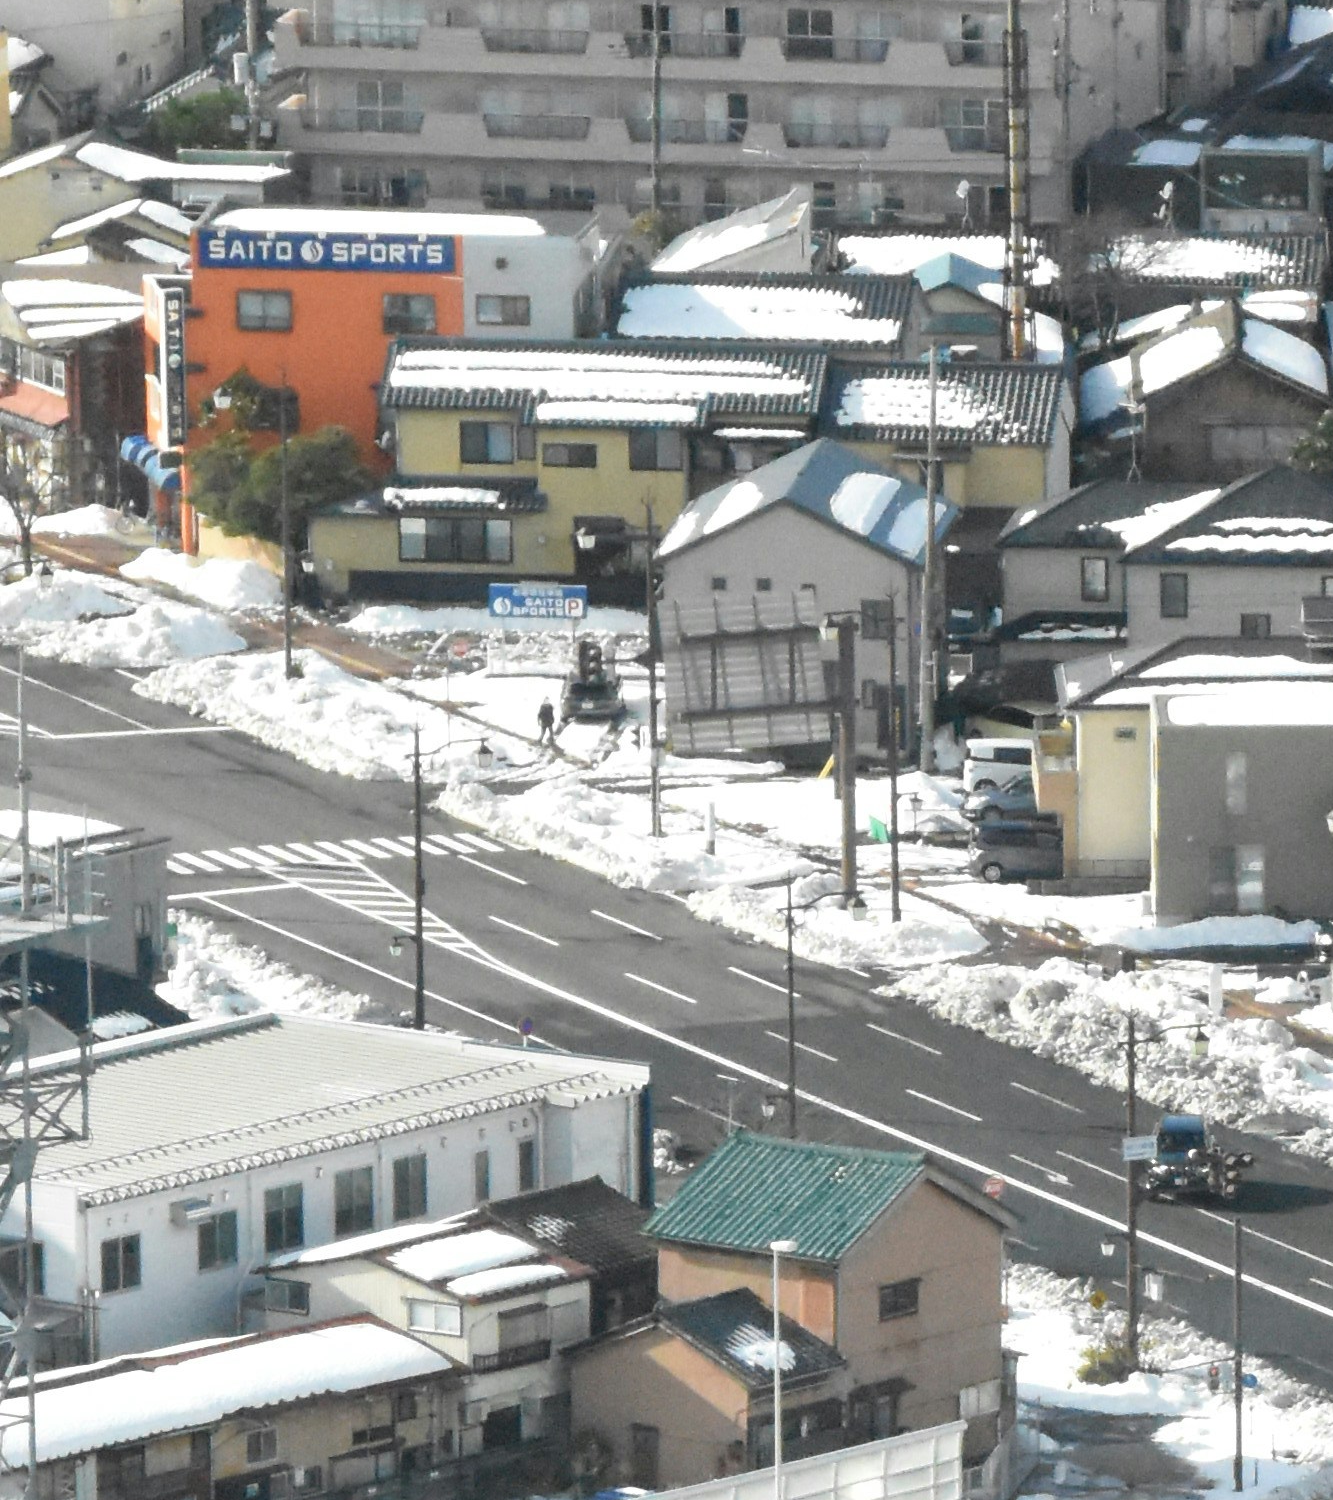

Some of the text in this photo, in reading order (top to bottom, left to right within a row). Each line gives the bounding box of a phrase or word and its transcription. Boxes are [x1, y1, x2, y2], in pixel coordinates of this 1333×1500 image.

[208, 239, 443, 264] SAITO SPORTS
[568, 599, 580, 615] P
